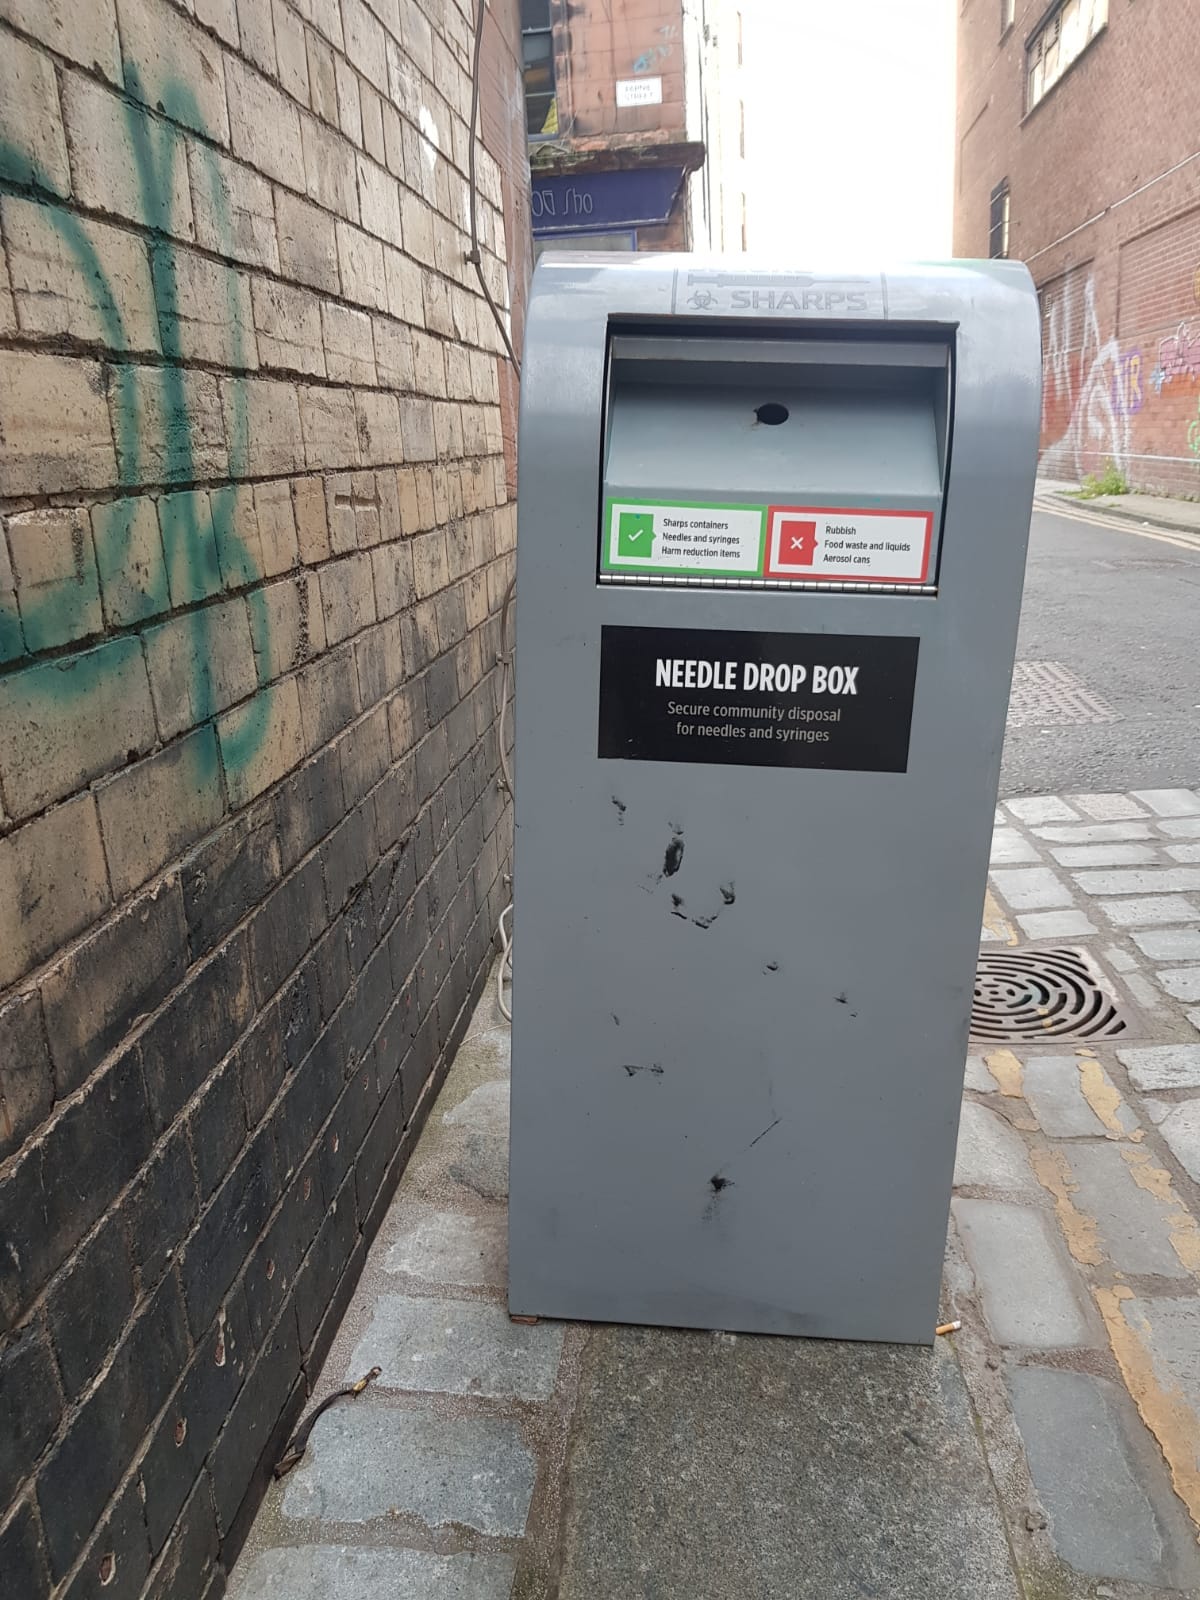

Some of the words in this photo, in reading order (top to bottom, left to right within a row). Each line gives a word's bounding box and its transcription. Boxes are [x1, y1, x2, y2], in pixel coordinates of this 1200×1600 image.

[730, 290, 867, 311] SHARPS
[663, 518, 689, 529] Sharps
[689, 520, 729, 530] containers
[825, 525, 857, 535] Rubbish
[662, 532, 692, 542] Needles
[693, 534, 708, 543] and
[708, 535, 740, 546] syringes
[824, 539, 844, 549] Food
[845, 541, 868, 550] waste
[869, 542, 884, 551] and
[885, 542, 911, 552] liquids
[661, 546, 682, 555] Harm
[682, 547, 719, 557] reduction
[719, 549, 741, 558] items
[823, 553, 852, 563] Aerosol
[852, 556, 871, 564] cans
[655, 658, 738, 690] NEEDLE
[743, 662, 807, 693] DROP
[812, 665, 859, 695] BOX
[667, 701, 711, 716] Secure
[713, 705, 785, 722] community
[787, 706, 841, 723] disposal
[676, 721, 695, 736] for
[697, 723, 746, 738] needles
[748, 725, 773, 739] and
[775, 727, 830, 743] syringes
